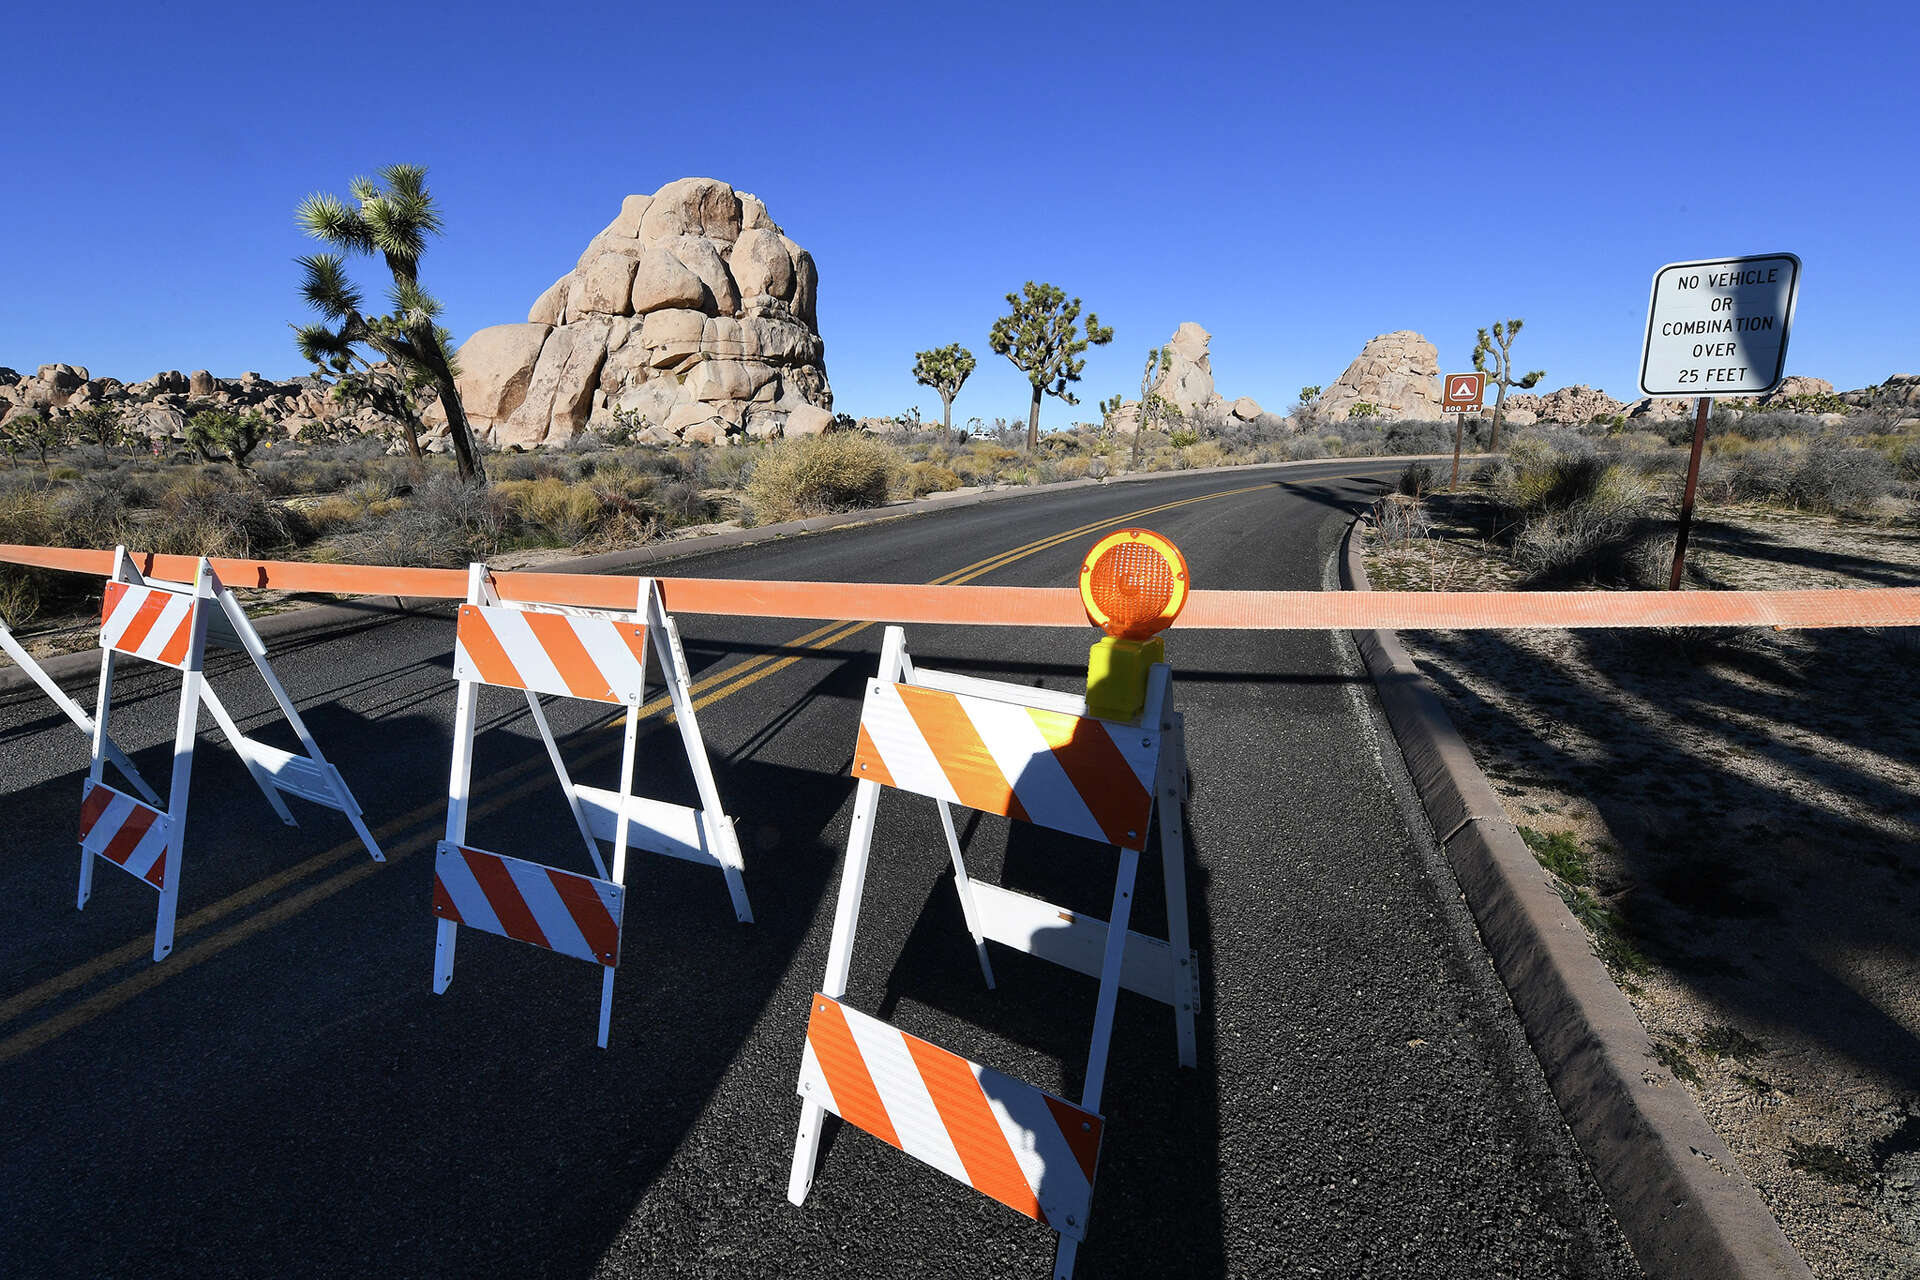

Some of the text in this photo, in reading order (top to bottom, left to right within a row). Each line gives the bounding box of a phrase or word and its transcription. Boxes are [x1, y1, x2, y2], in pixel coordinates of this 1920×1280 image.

[1678, 269, 1778, 290] NO VEHICLE
[1711, 297, 1733, 311] OR
[1662, 316, 1773, 336] COMBINATION
[1693, 343, 1736, 357] OVER
[1678, 367, 1747, 383] 25 FEET
